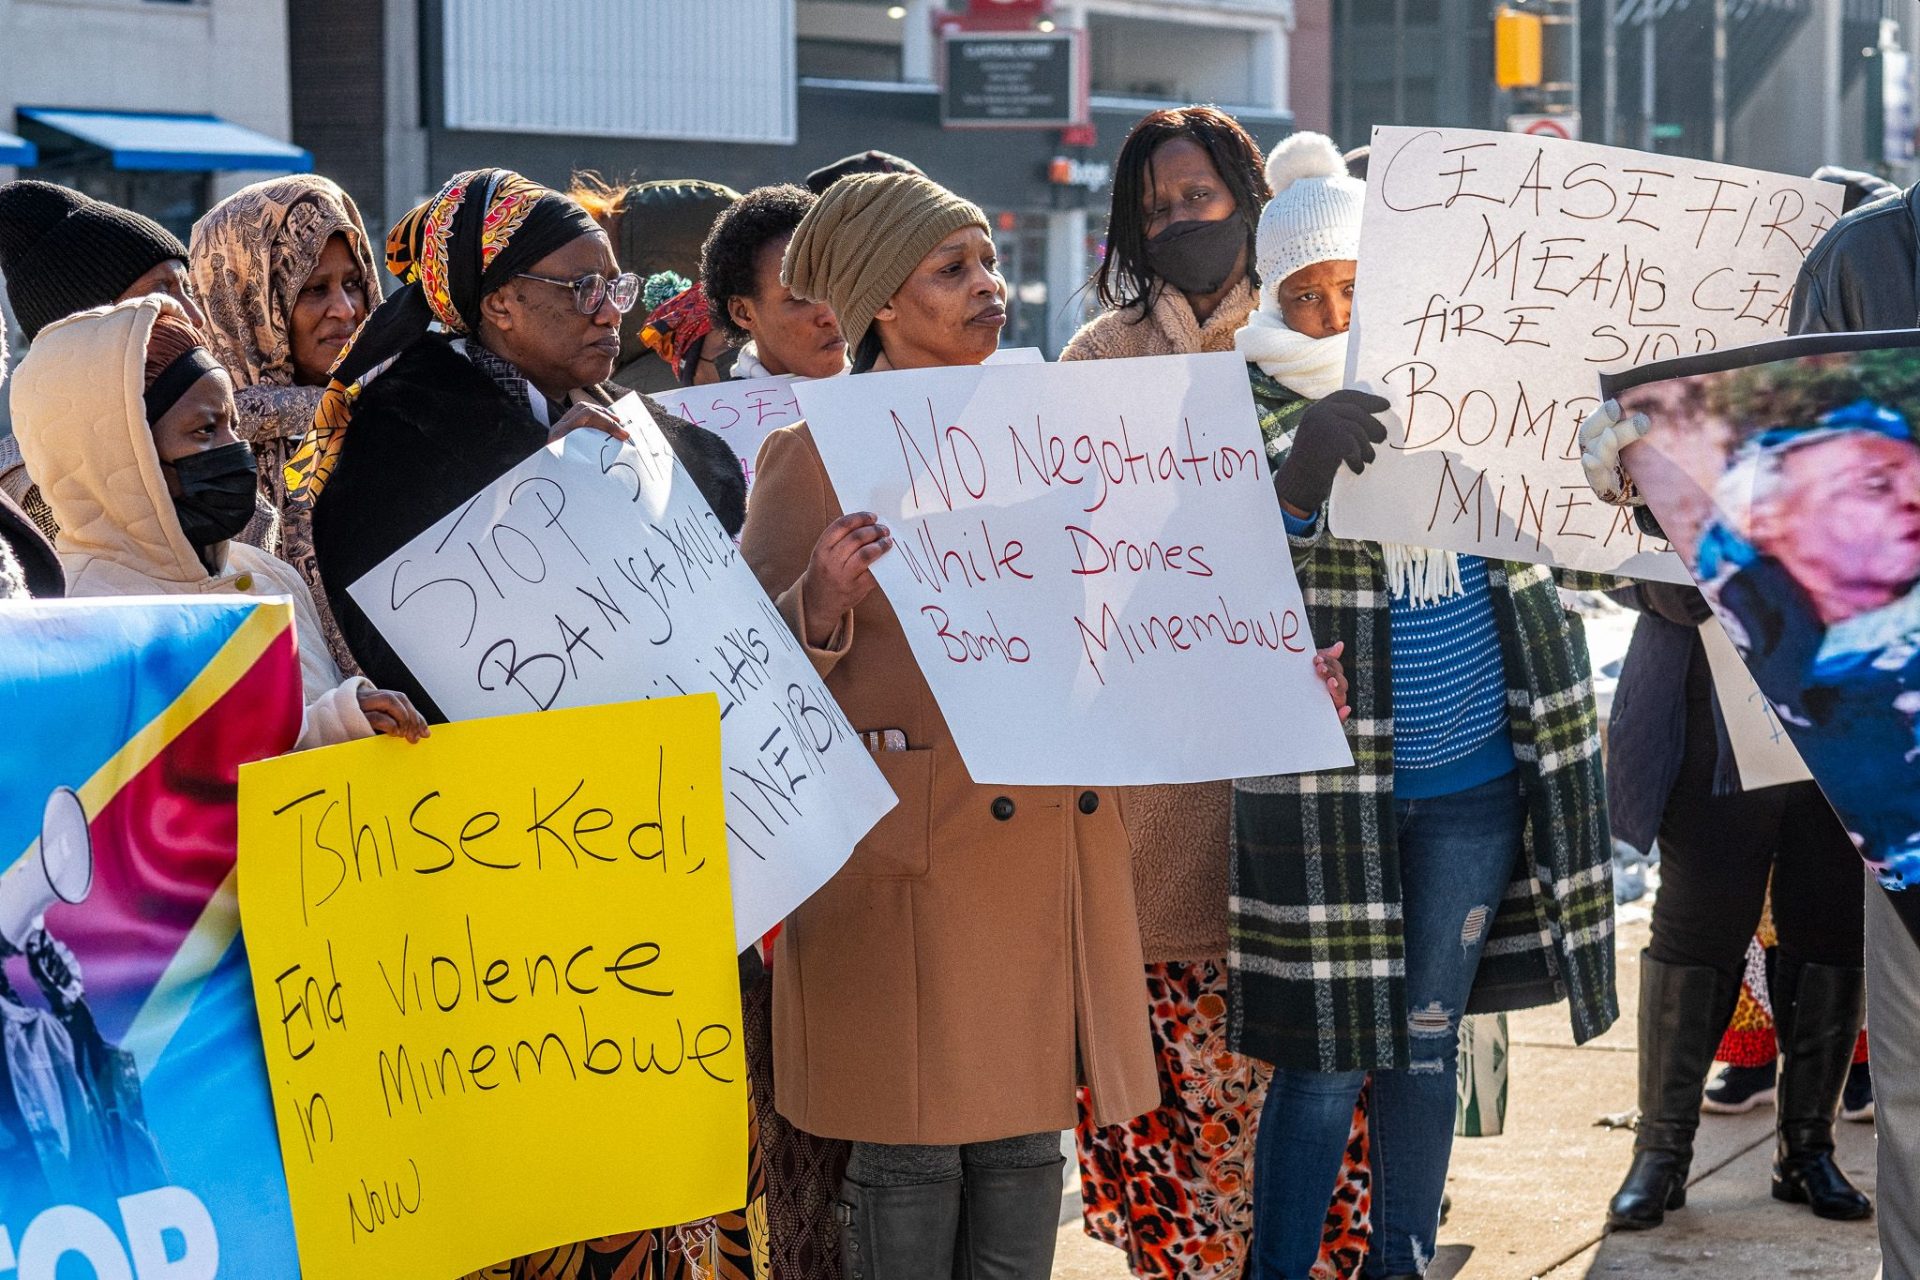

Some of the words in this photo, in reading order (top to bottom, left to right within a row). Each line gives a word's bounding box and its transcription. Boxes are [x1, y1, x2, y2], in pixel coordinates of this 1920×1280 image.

[1382, 131, 1674, 231] CEASE
[1460, 214, 1666, 312] MEANS
[1009, 414, 1260, 512] Negotiation
[391, 476, 591, 647] STOP
[892, 518, 1034, 593] While
[1065, 526, 1213, 576] Drones
[921, 605, 1031, 664] Bomb
[1074, 596, 1305, 685] Minembwe
[276, 939, 347, 1061] End
[286, 1081, 334, 1163] in
[379, 1006, 735, 1118] Minembwe
